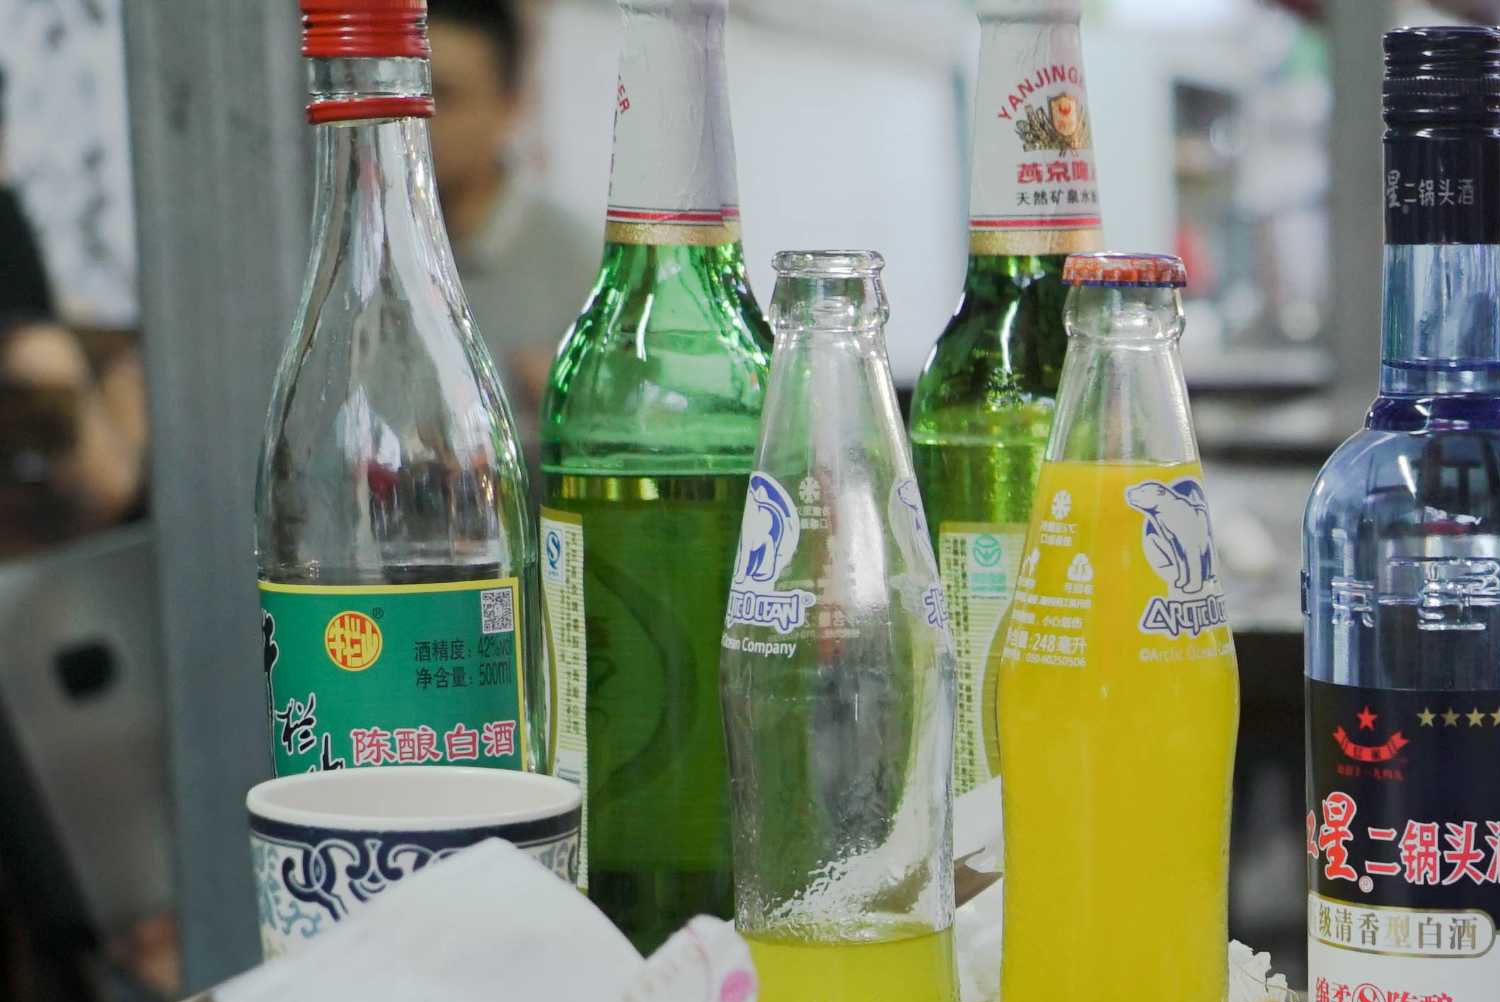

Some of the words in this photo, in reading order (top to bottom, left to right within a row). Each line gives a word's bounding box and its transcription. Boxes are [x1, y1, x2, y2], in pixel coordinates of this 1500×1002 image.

[742, 636, 797, 659] Company
[352, 720, 517, 766] 陈酿白酒
